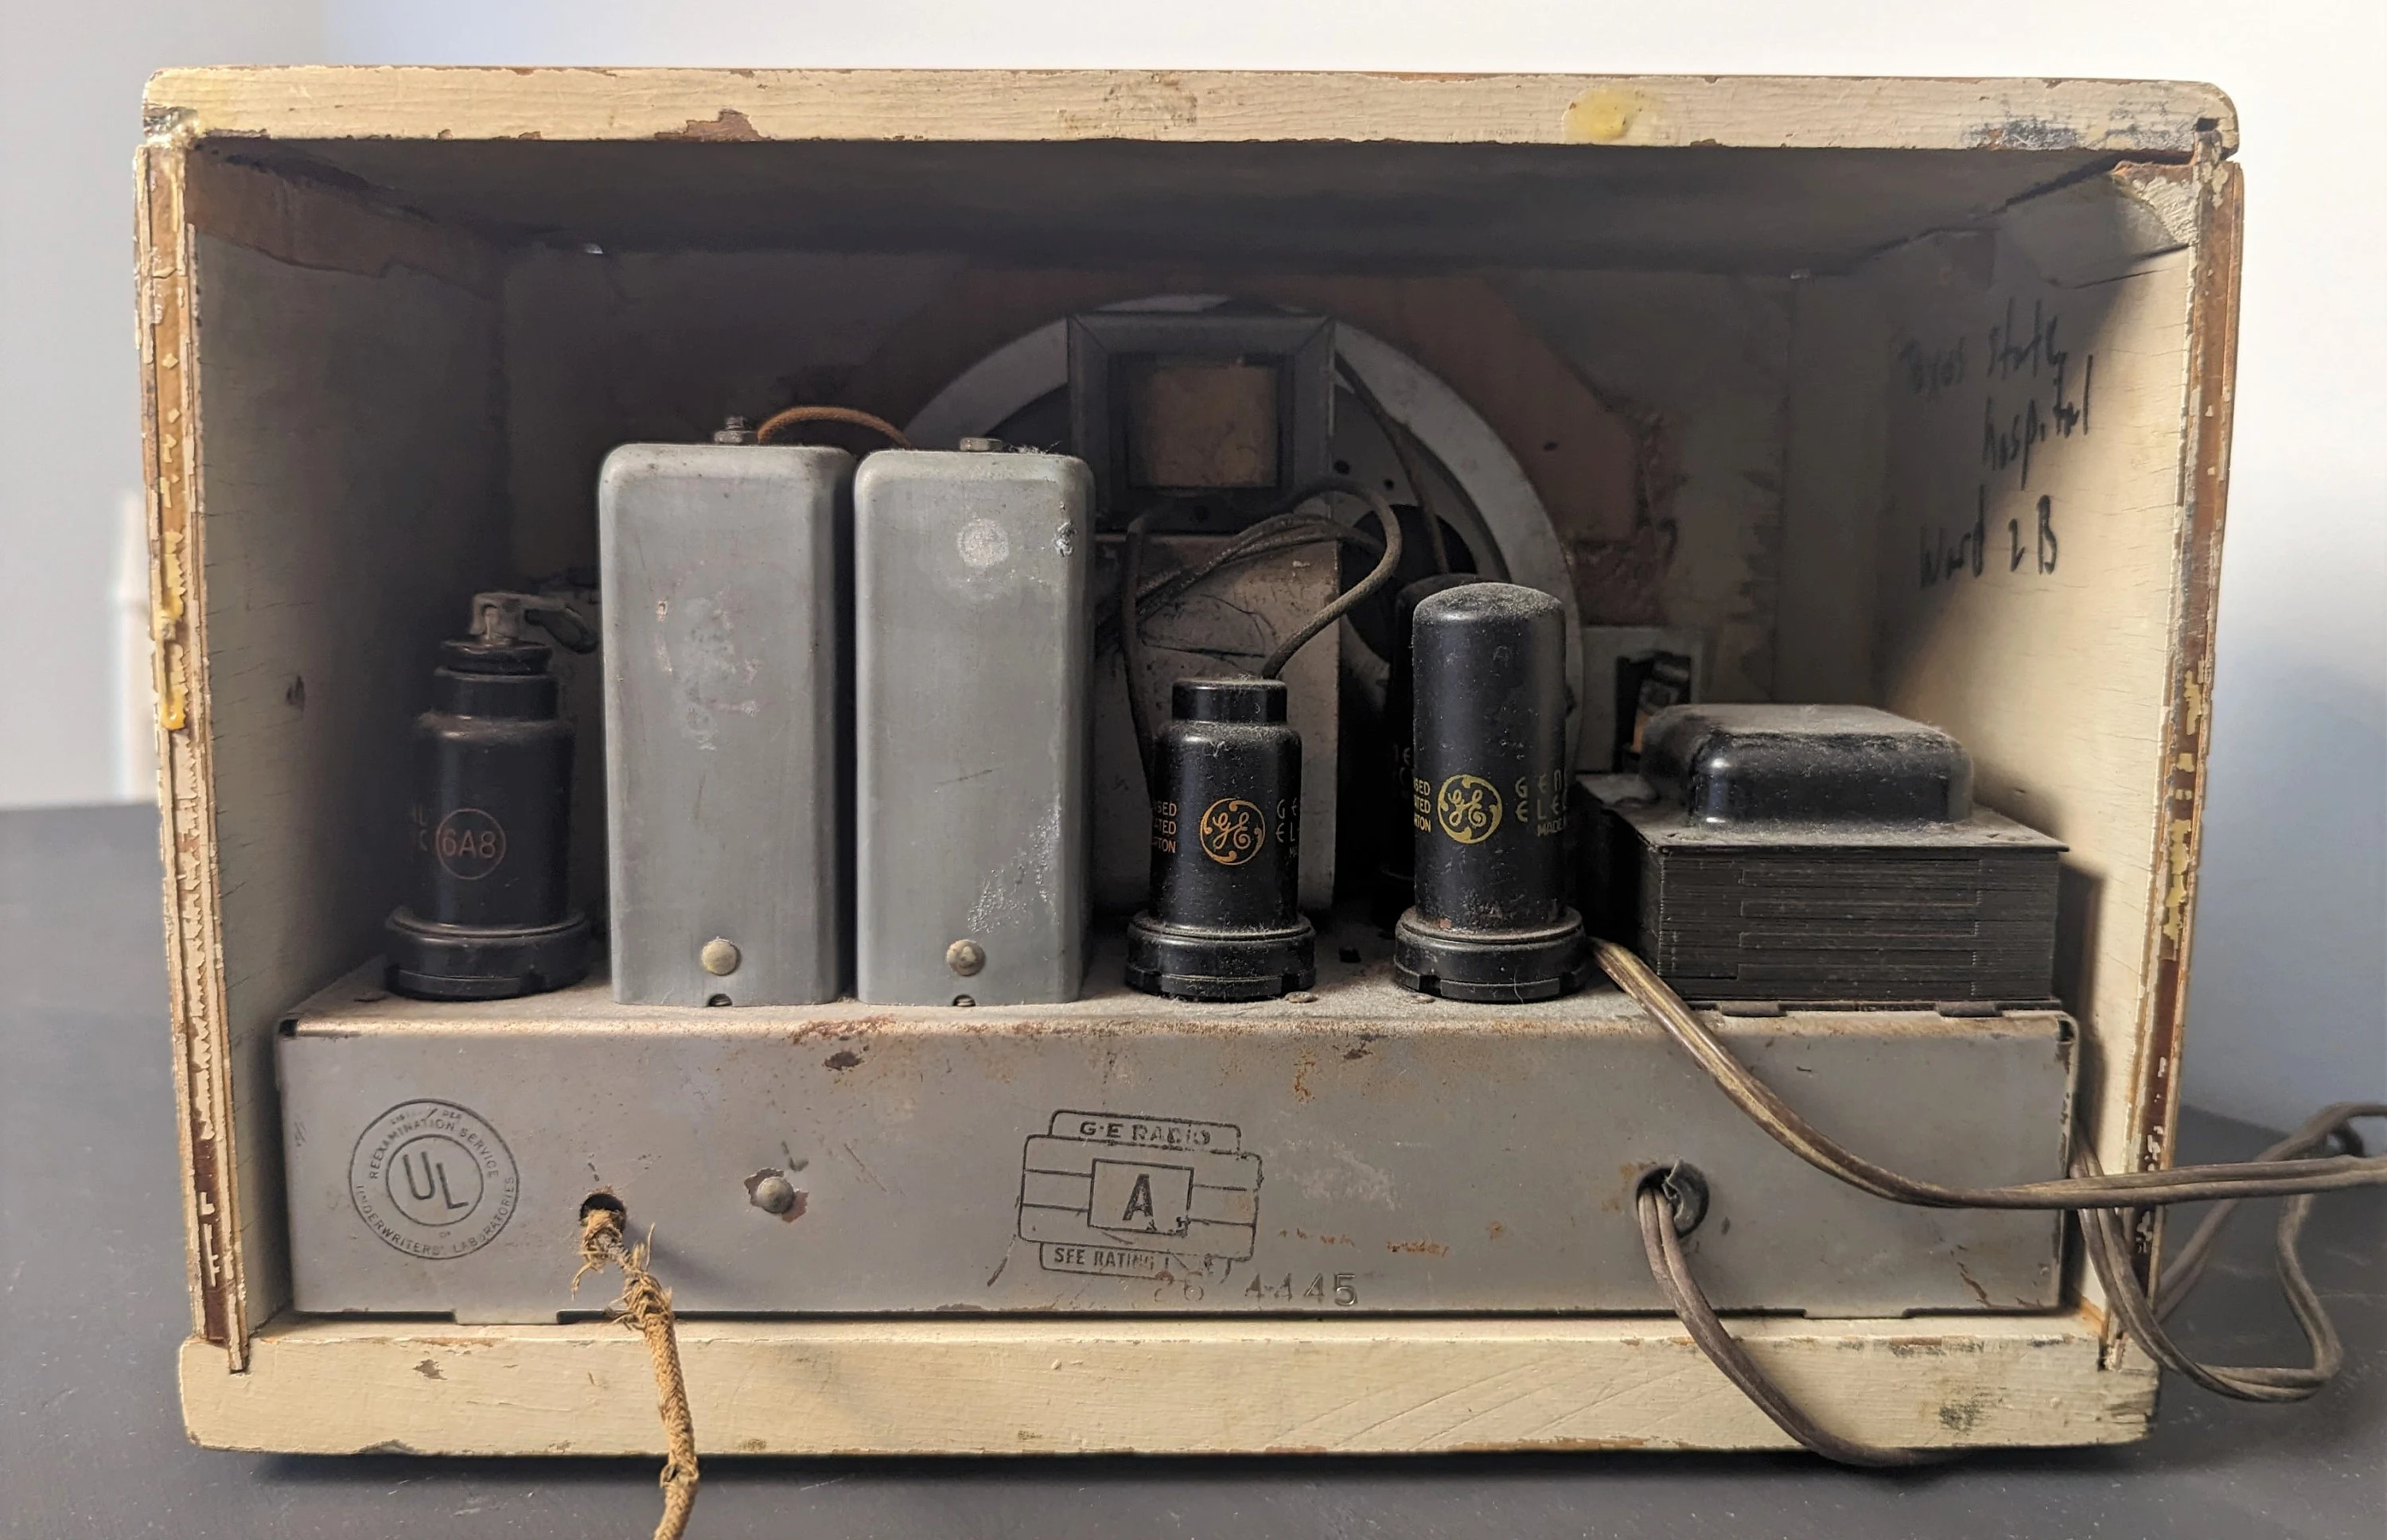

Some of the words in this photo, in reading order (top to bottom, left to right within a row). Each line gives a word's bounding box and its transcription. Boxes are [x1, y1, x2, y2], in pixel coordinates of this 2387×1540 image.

[442, 829, 496, 859] 6A8
[369, 1118, 456, 1180] REEXAMINATION
[460, 1126, 500, 1179] SERVICE
[403, 1150, 469, 1210] UL
[1122, 1172, 1156, 1221] A
[452, 1176, 515, 1254] LABORATORIES
